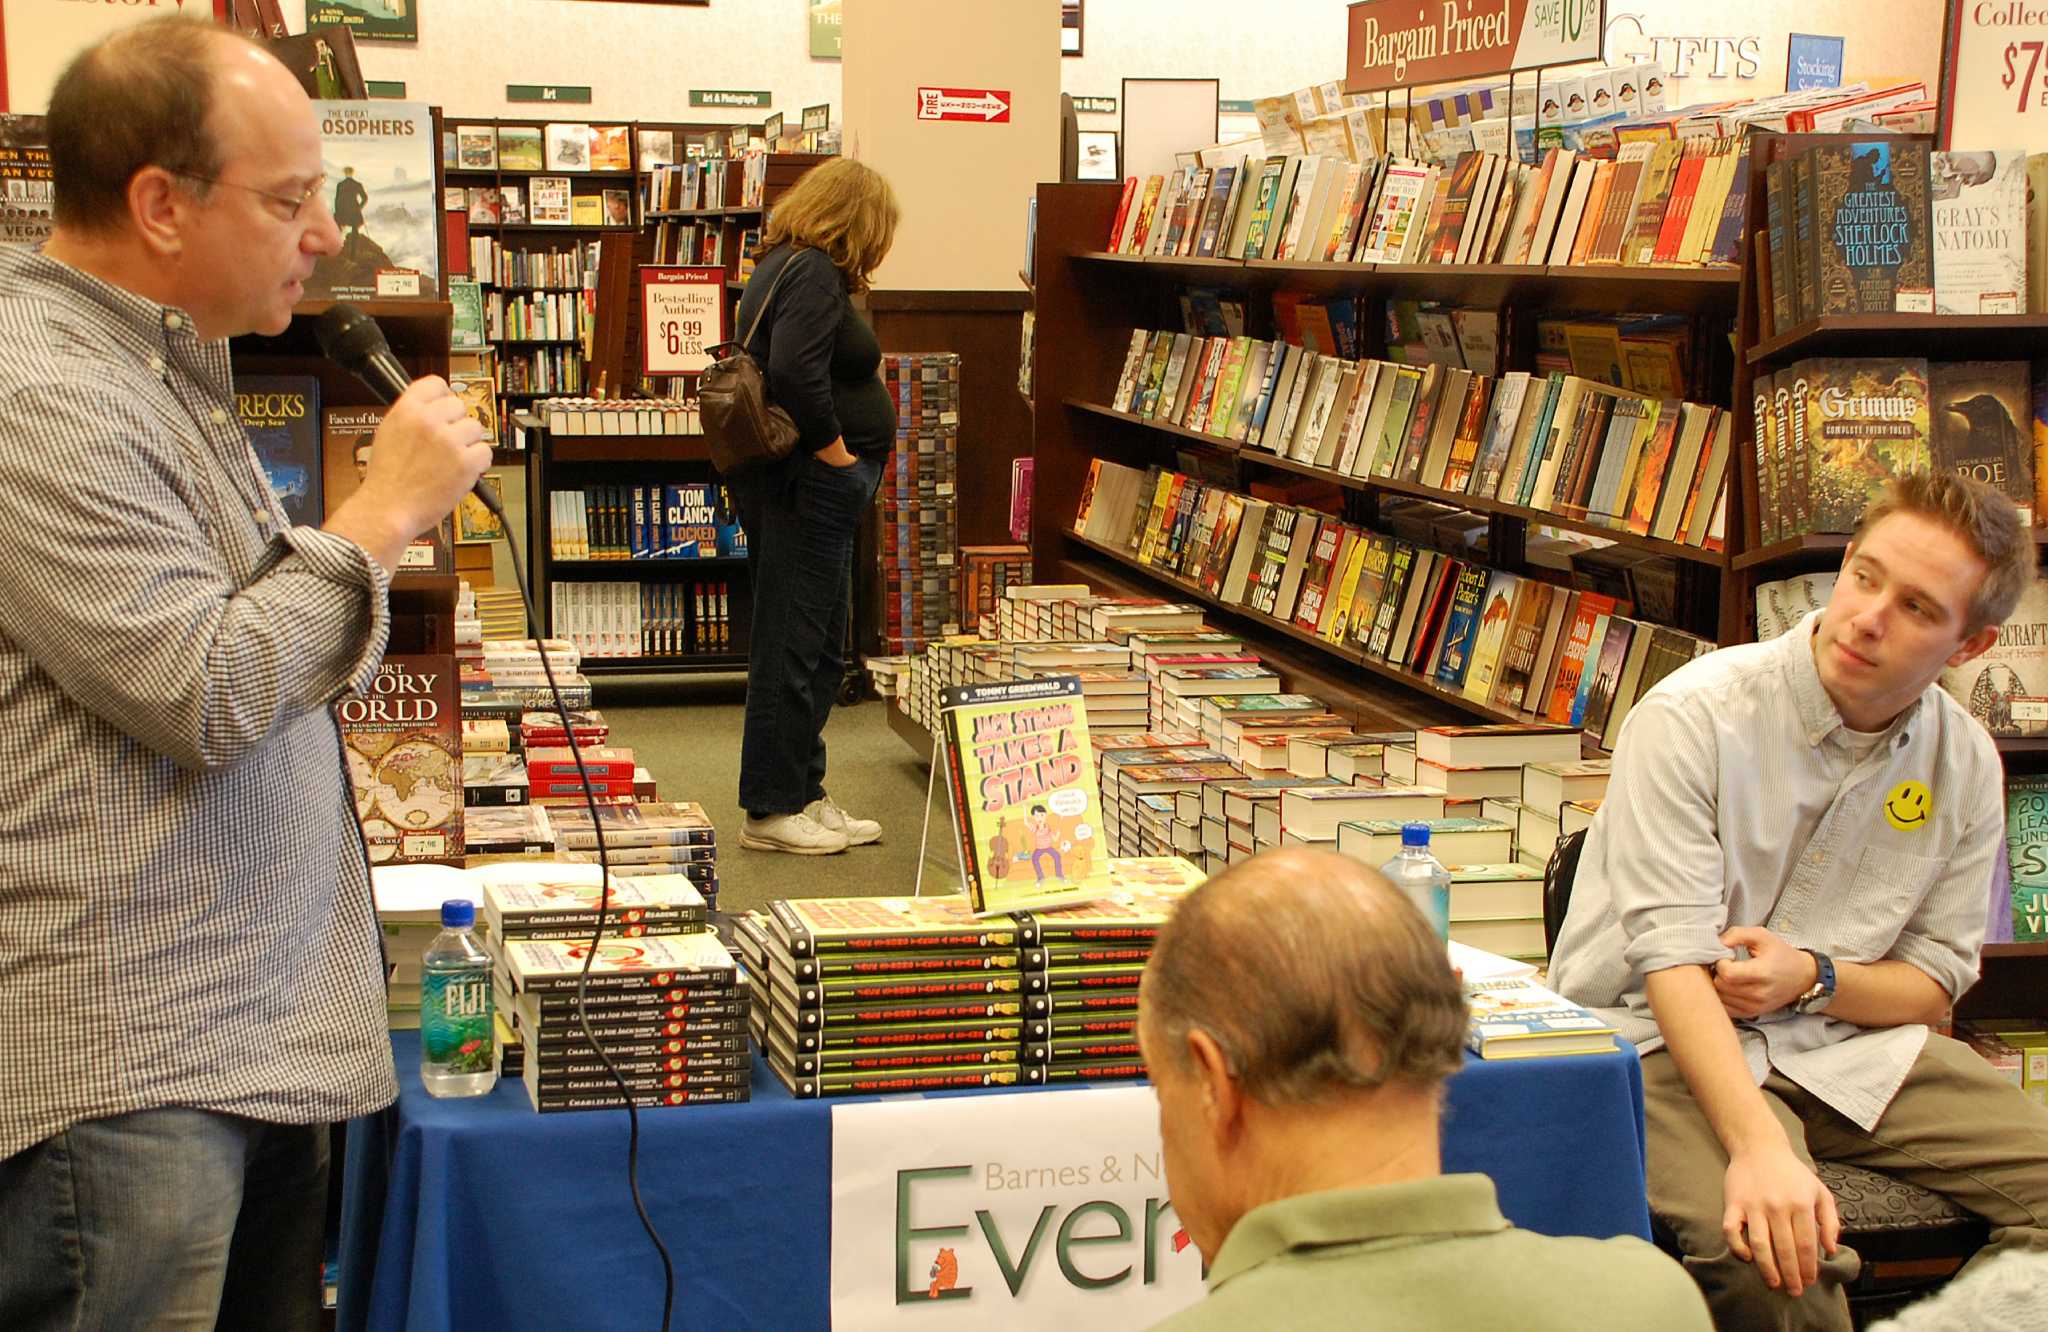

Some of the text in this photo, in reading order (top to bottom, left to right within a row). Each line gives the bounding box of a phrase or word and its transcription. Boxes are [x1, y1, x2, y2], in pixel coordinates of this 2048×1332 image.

[1535, 1, 1559, 28] SAVE
[1363, 0, 1511, 82] Bargain Priced
[1603, 13, 1760, 79] GIFTS
[1797, 56, 1837, 82] Stocking
[543, 88, 556, 100] Art
[702, 93, 714, 103] Art
[926, 93, 938, 115] FIRE
[328, 109, 369, 118] THE GREAT
[1844, 192, 1896, 207] GREATEST
[1836, 207, 1907, 224] ADVENTURES
[1936, 206, 2000, 227] GRAY'S
[1835, 223, 1909, 245] SHERLOCK
[1845, 244, 1902, 267] HOLMES
[657, 272, 709, 282] Bargain Priced
[653, 292, 714, 305] Bestselling
[663, 304, 706, 315] Authors
[680, 341, 703, 355] LESS
[236, 393, 305, 417] RECKS
[244, 418, 286, 428] Deep Seas
[328, 412, 383, 425] Faces of the
[1826, 425, 1862, 435] COMPLETE
[678, 489, 705, 508] TOM
[668, 506, 715, 525] CLANCY
[671, 526, 717, 542] LOCKED
[372, 673, 439, 695] ORY
[975, 686, 1007, 697] TOMMY
[1007, 682, 1061, 694] GREENWALD
[341, 698, 439, 722] ORLD
[536, 700, 579, 708] RECPES
[974, 703, 1075, 744] JACK STRONG
[976, 728, 1078, 774] TAKES A
[982, 754, 1082, 812] STAND
[530, 915, 565, 924] CHARLIE
[565, 914, 578, 923] JOE
[645, 910, 679, 919] READING
[532, 931, 568, 939] CHARLIE
[568, 930, 579, 938] JOE
[647, 926, 680, 934] READING
[555, 973, 710, 988] CHARE JOE JACKSON'S READING
[445, 982, 487, 1017] FIJI
[606, 990, 722, 1003] JOE JACKSON'S READING
[607, 1011, 621, 1019] JOE
[622, 1010, 659, 1018] JACKSON'S
[690, 1006, 724, 1014] READING
[603, 1028, 618, 1036] JOE
[618, 1026, 656, 1035] JACKSON'S
[686, 1023, 721, 1031] READING
[604, 1046, 618, 1054] JOE
[618, 1045, 656, 1054] JACKSON'S
[686, 1041, 721, 1049] READING
[568, 1064, 604, 1073] CHARLIE
[618, 1062, 657, 1071] JACKSON'S
[687, 1058, 722, 1066] READING
[568, 1080, 604, 1089] CHARLIE
[604, 1079, 618, 1087] JOE
[688, 1075, 722, 1083] READING
[569, 1098, 605, 1107] CHARLIE
[605, 1097, 619, 1106] JOE
[688, 1092, 723, 1100] READING
[985, 1162, 1090, 1192] Barnes
[1100, 1155, 1123, 1184] &
